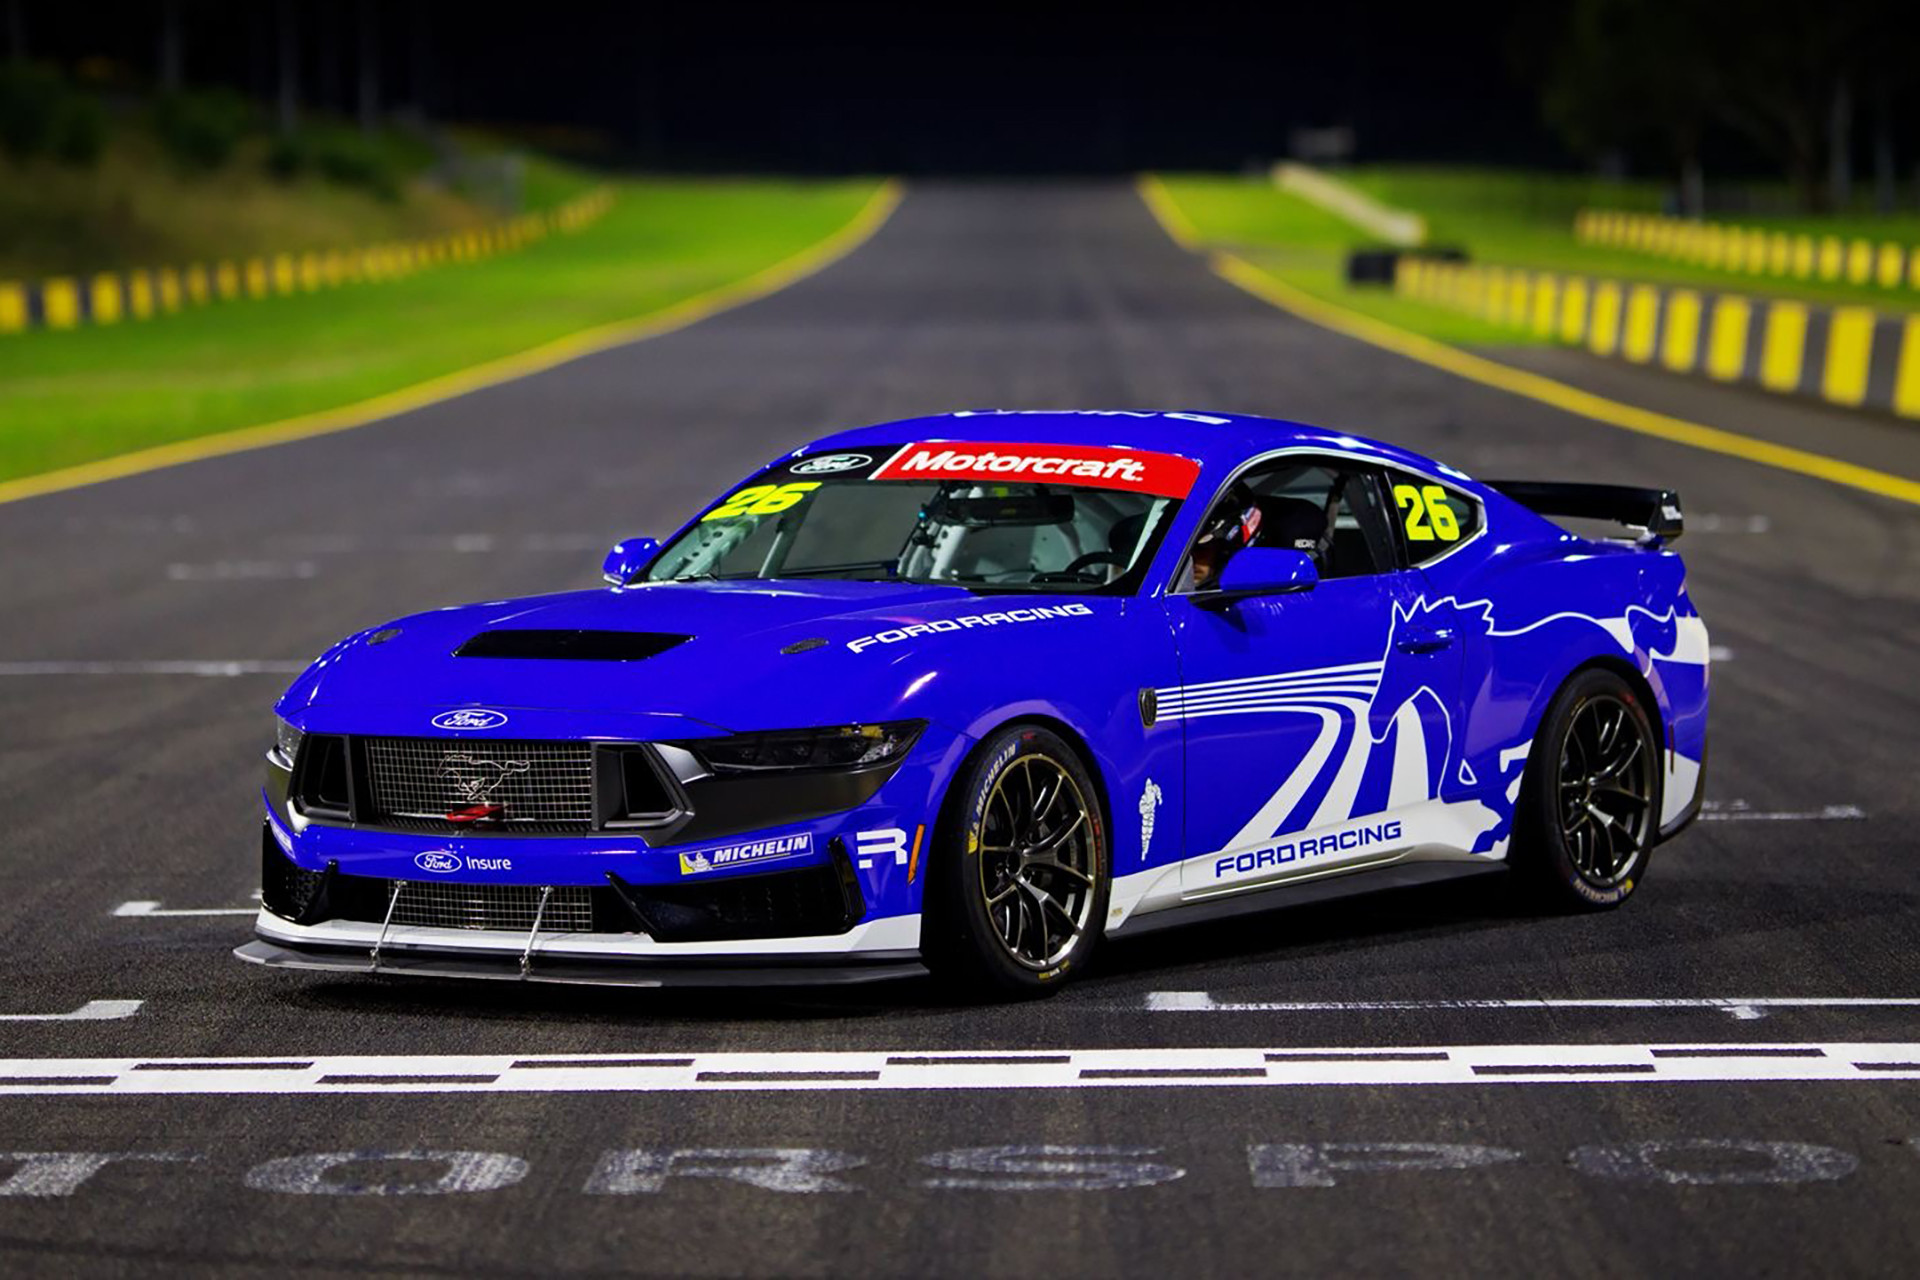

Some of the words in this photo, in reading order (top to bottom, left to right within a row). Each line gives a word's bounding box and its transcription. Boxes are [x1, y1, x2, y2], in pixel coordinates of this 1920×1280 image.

[799, 456, 860, 472] Ford
[901, 450, 1146, 482] Motorcraft
[701, 481, 824, 522] 26
[1393, 484, 1460, 541] 26
[846, 619, 962, 654] FORD
[955, 603, 1094, 628] RACING
[443, 710, 495, 727] Ford
[975, 742, 1016, 816] MICHELIN
[423, 854, 453, 870] Ford
[466, 856, 512, 870] Insure
[712, 835, 810, 864] MICHELIN
[1215, 843, 1296, 878] FORD
[1299, 820, 1402, 859] RACING
